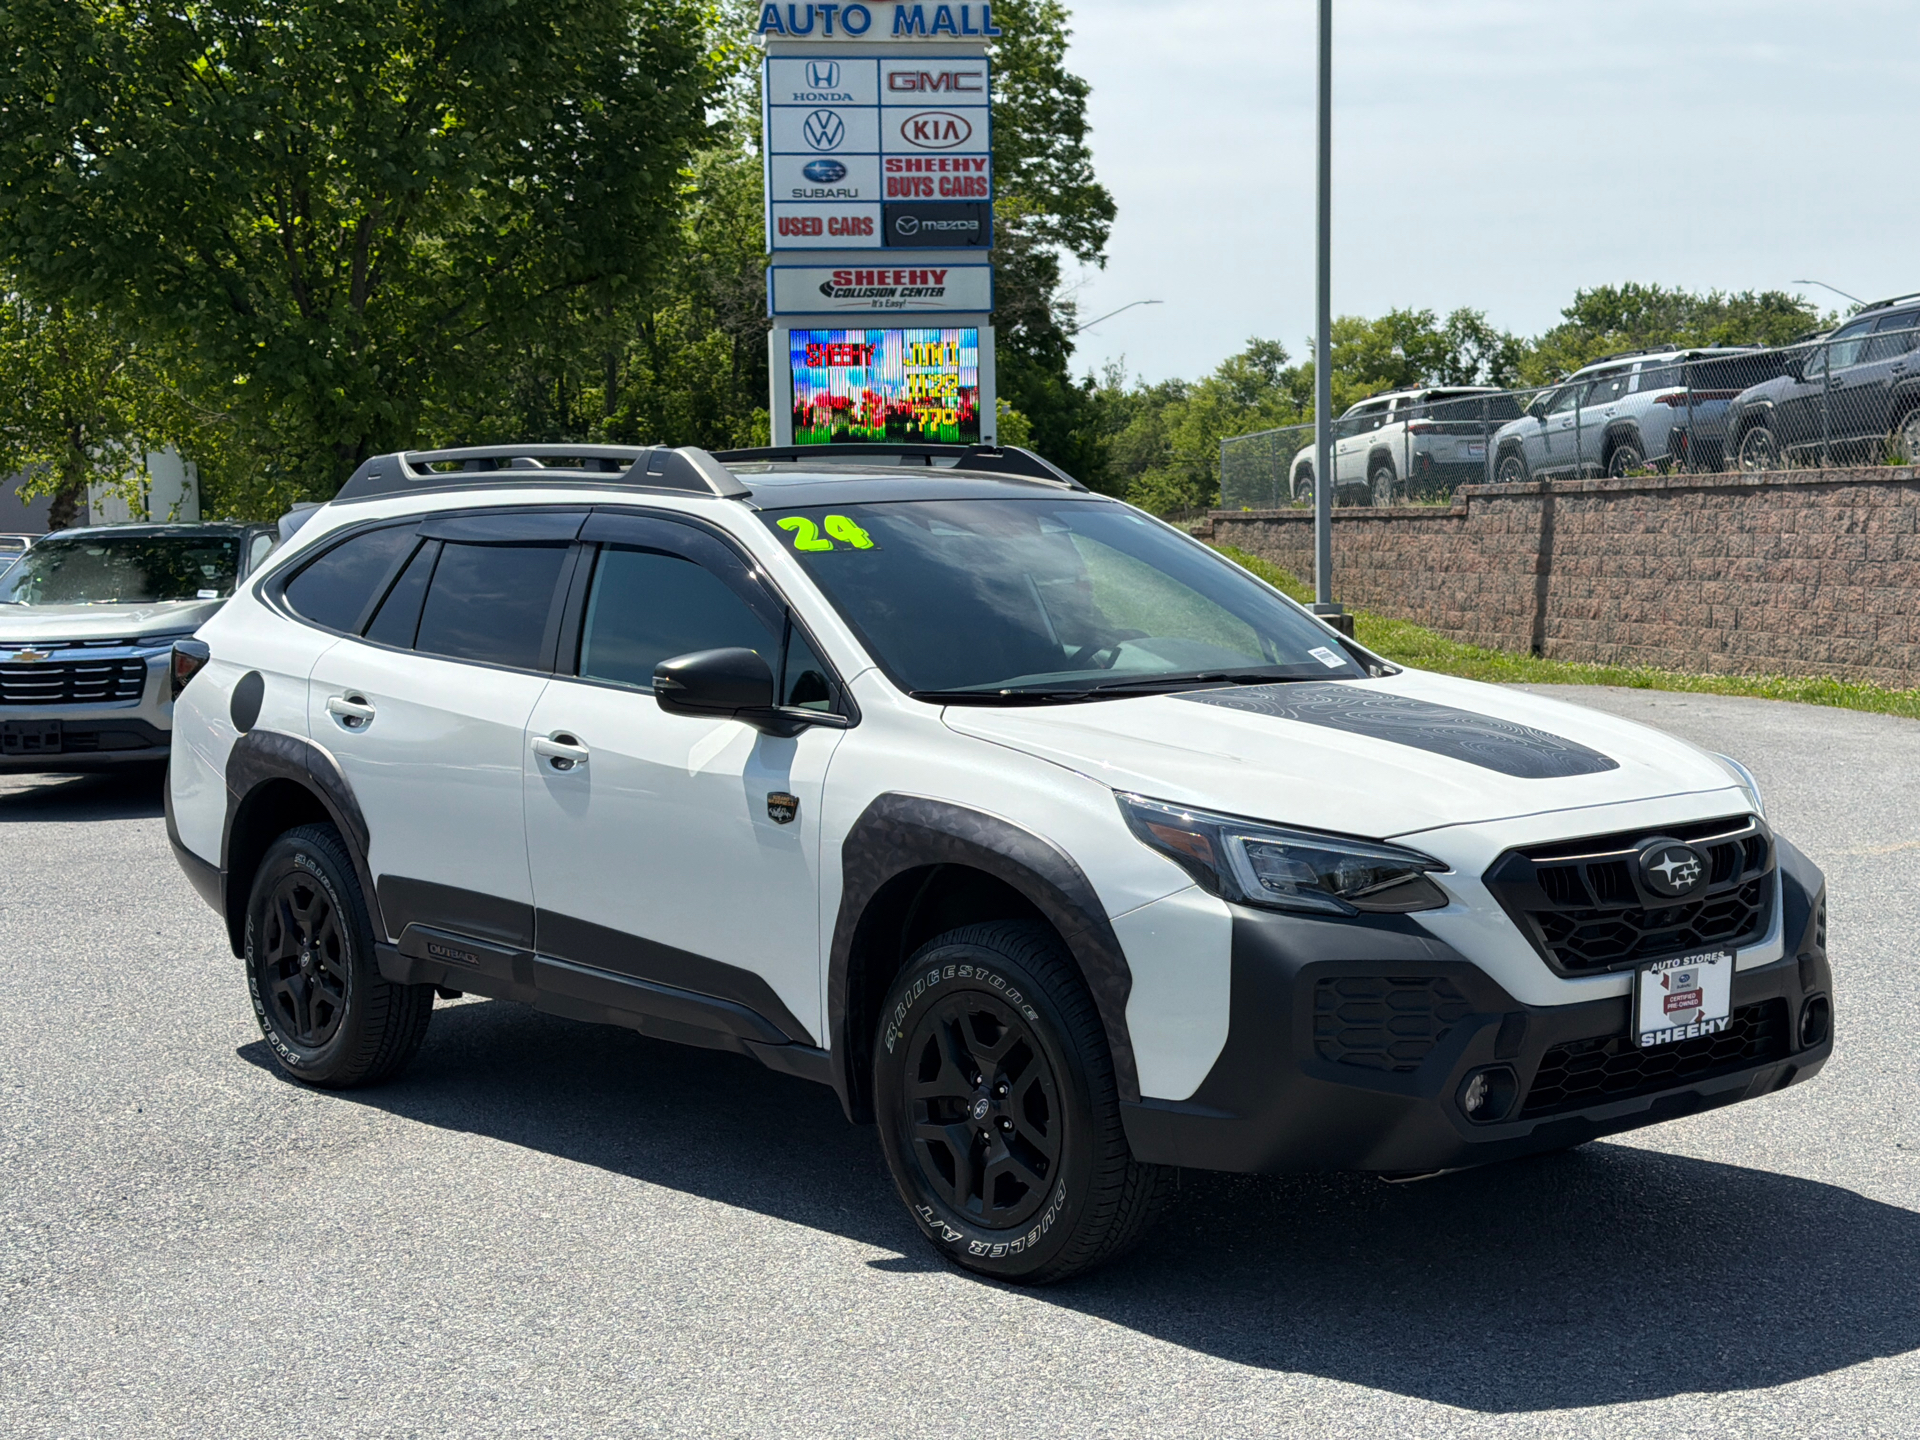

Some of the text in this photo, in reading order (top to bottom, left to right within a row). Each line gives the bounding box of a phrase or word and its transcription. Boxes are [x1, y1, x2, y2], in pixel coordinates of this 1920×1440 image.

[757, 4, 1002, 37] AUTO MALL
[888, 70, 983, 93] GMC
[792, 92, 854, 102] HONDA
[913, 120, 961, 140] KIA
[885, 158, 987, 173] SHEEHY
[792, 188, 859, 198] SUBARU
[887, 176, 988, 197] BUYS CARS
[778, 216, 874, 236] USED CARS
[922, 220, 979, 231] mazda
[832, 269, 948, 286] SHEEHY
[833, 286, 946, 299] COLLISION CENTER
[871, 299, 907, 309] It's Easy!
[806, 343, 876, 367] SHEEHY
[776, 515, 875, 552] 24
[429, 944, 480, 965] OUTBACK
[1650, 950, 1725, 972] AUTO STORES
[1667, 998, 1699, 1009] PRE-OWNED
[1670, 992, 1697, 1002] CERTIFIED
[885, 964, 1039, 1054] BRIDGESTONE
[1641, 1017, 1730, 1048] SHEEHY
[916, 1178, 1067, 1258] DUELER A/T
